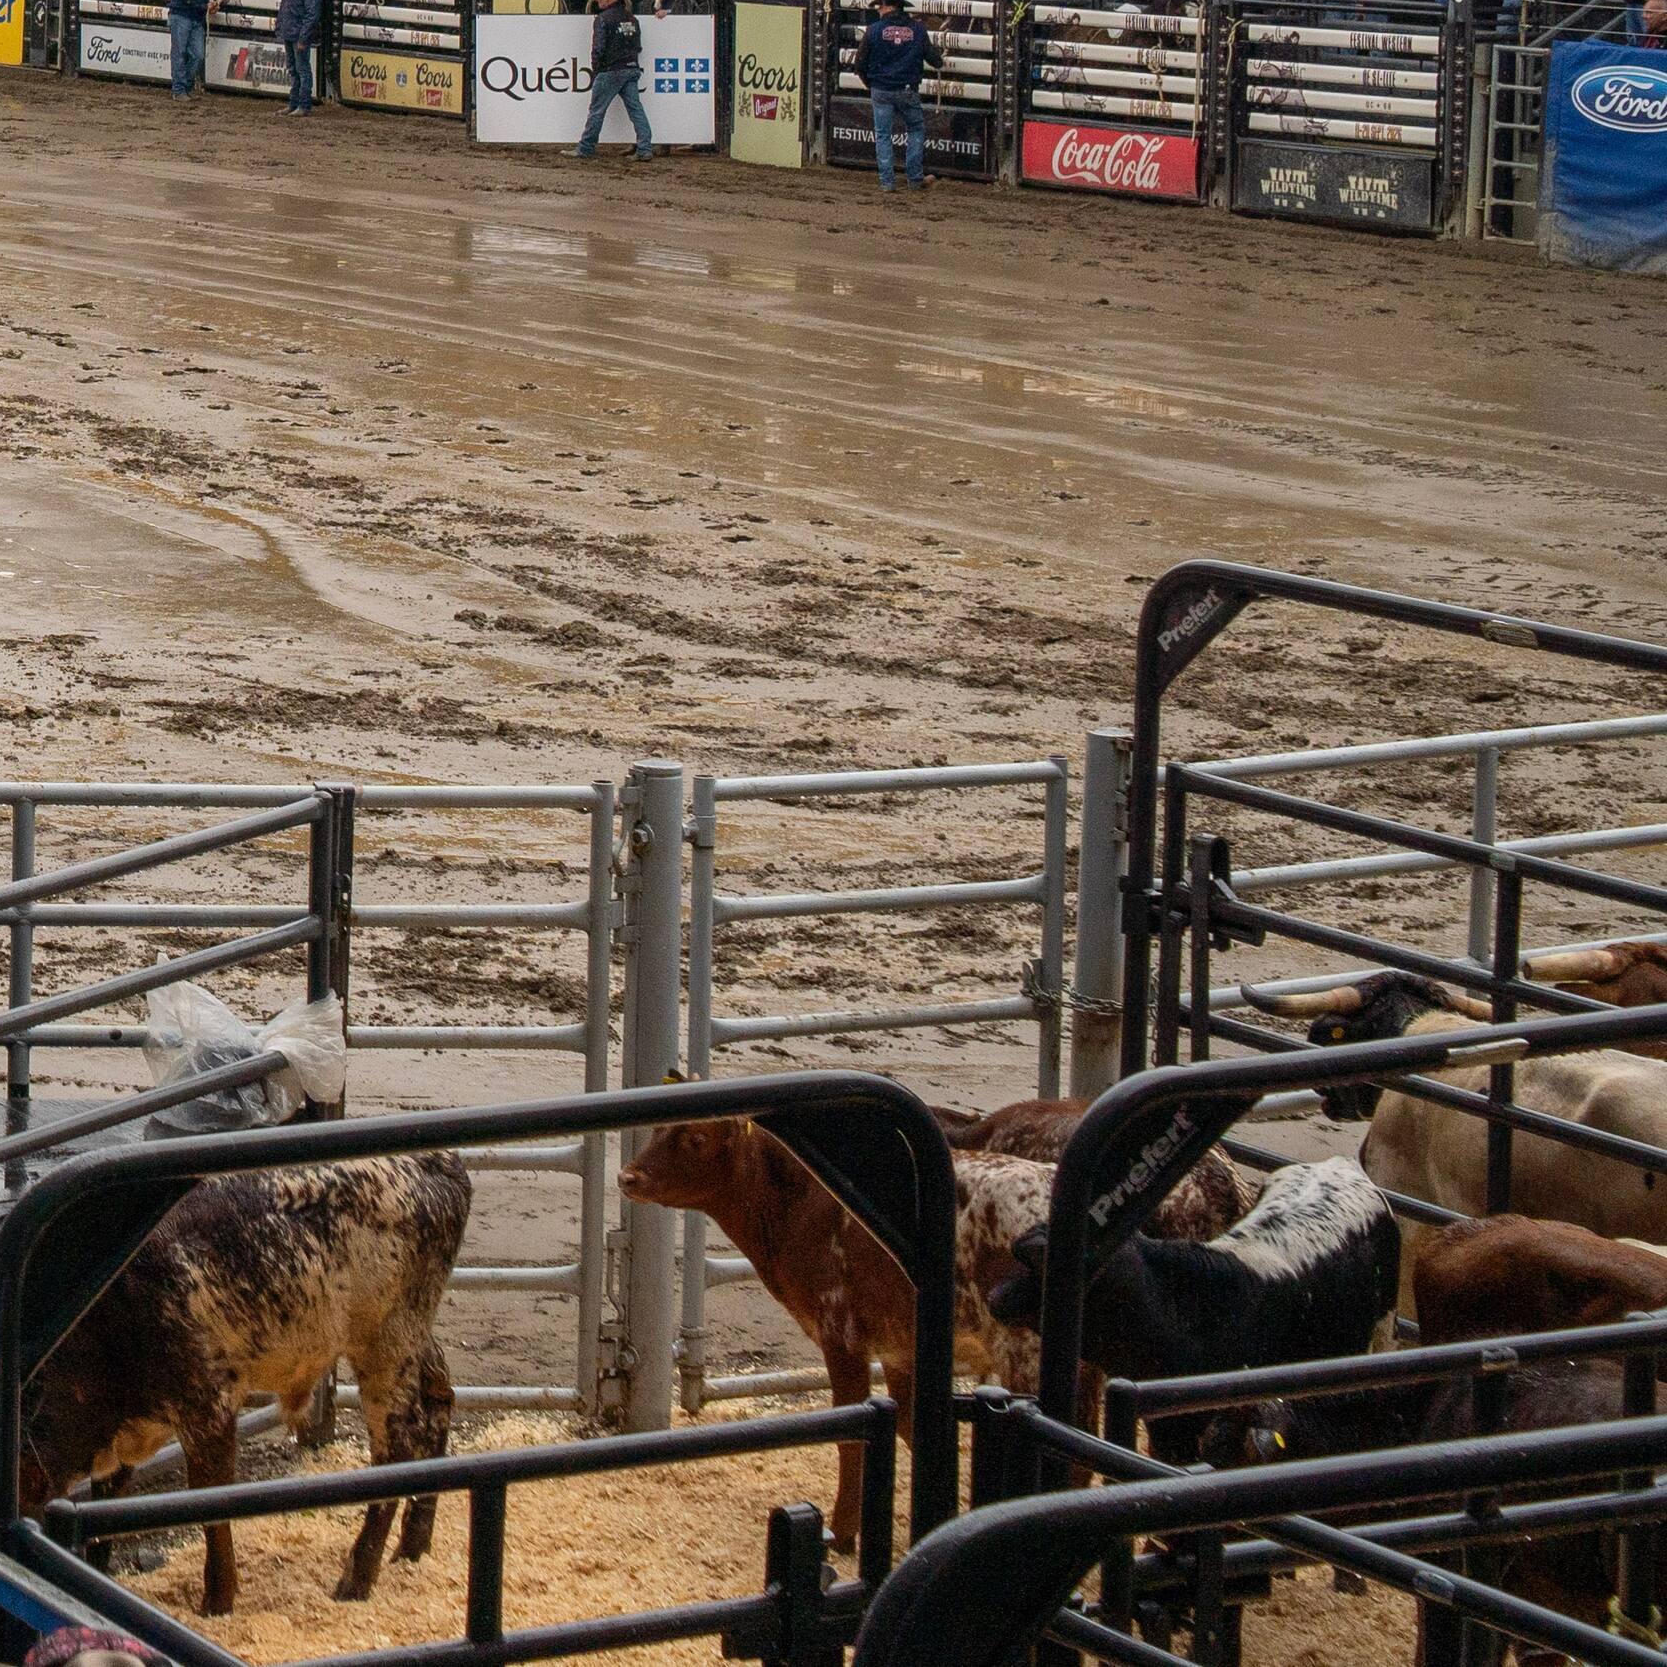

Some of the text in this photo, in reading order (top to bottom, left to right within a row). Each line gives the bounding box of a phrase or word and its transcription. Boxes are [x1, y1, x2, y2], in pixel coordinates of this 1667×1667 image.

[1125, 14, 1182, 34] FESTIVAL WESTERN
[87, 36, 171, 65] Ford CONSTRUIT AVEC FIER
[1350, 32, 1413, 52] FESTIVAL WESTERN
[351, 56, 387, 81] Coors
[416, 62, 453, 89] Coors
[481, 56, 647, 101] Québ
[738, 54, 798, 92] Coors
[755, 97, 777, 117] Original
[1595, 76, 1667, 121] Ford
[1052, 128, 1165, 190] Coca-Cola
[1157, 587, 1223, 653] Priefert
[1087, 1104, 1196, 1228] Priefert
